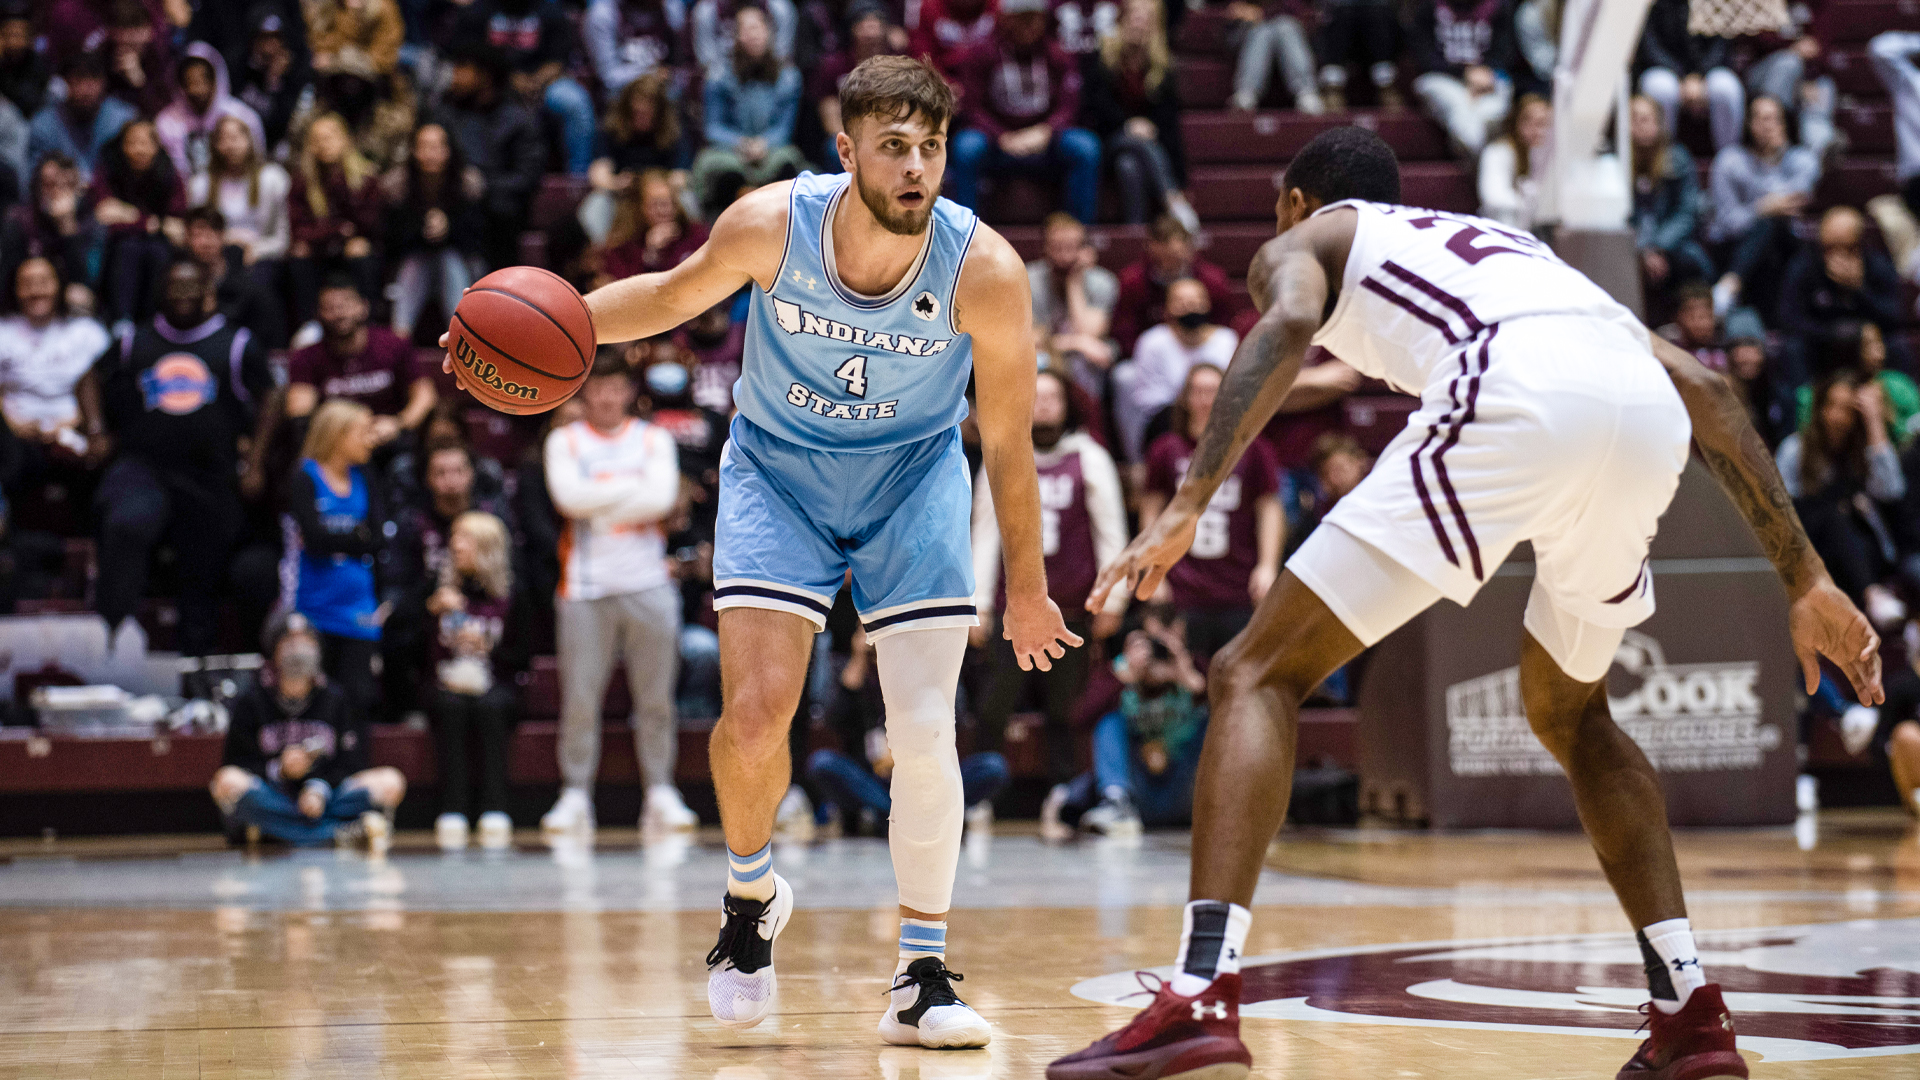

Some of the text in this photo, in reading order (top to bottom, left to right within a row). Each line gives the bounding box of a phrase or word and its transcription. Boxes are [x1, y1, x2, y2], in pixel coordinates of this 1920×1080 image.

[773, 295, 952, 356] INDIANA
[456, 334, 540, 400] Wilson
[834, 355, 868, 399] 4
[786, 382, 899, 420] STATE
